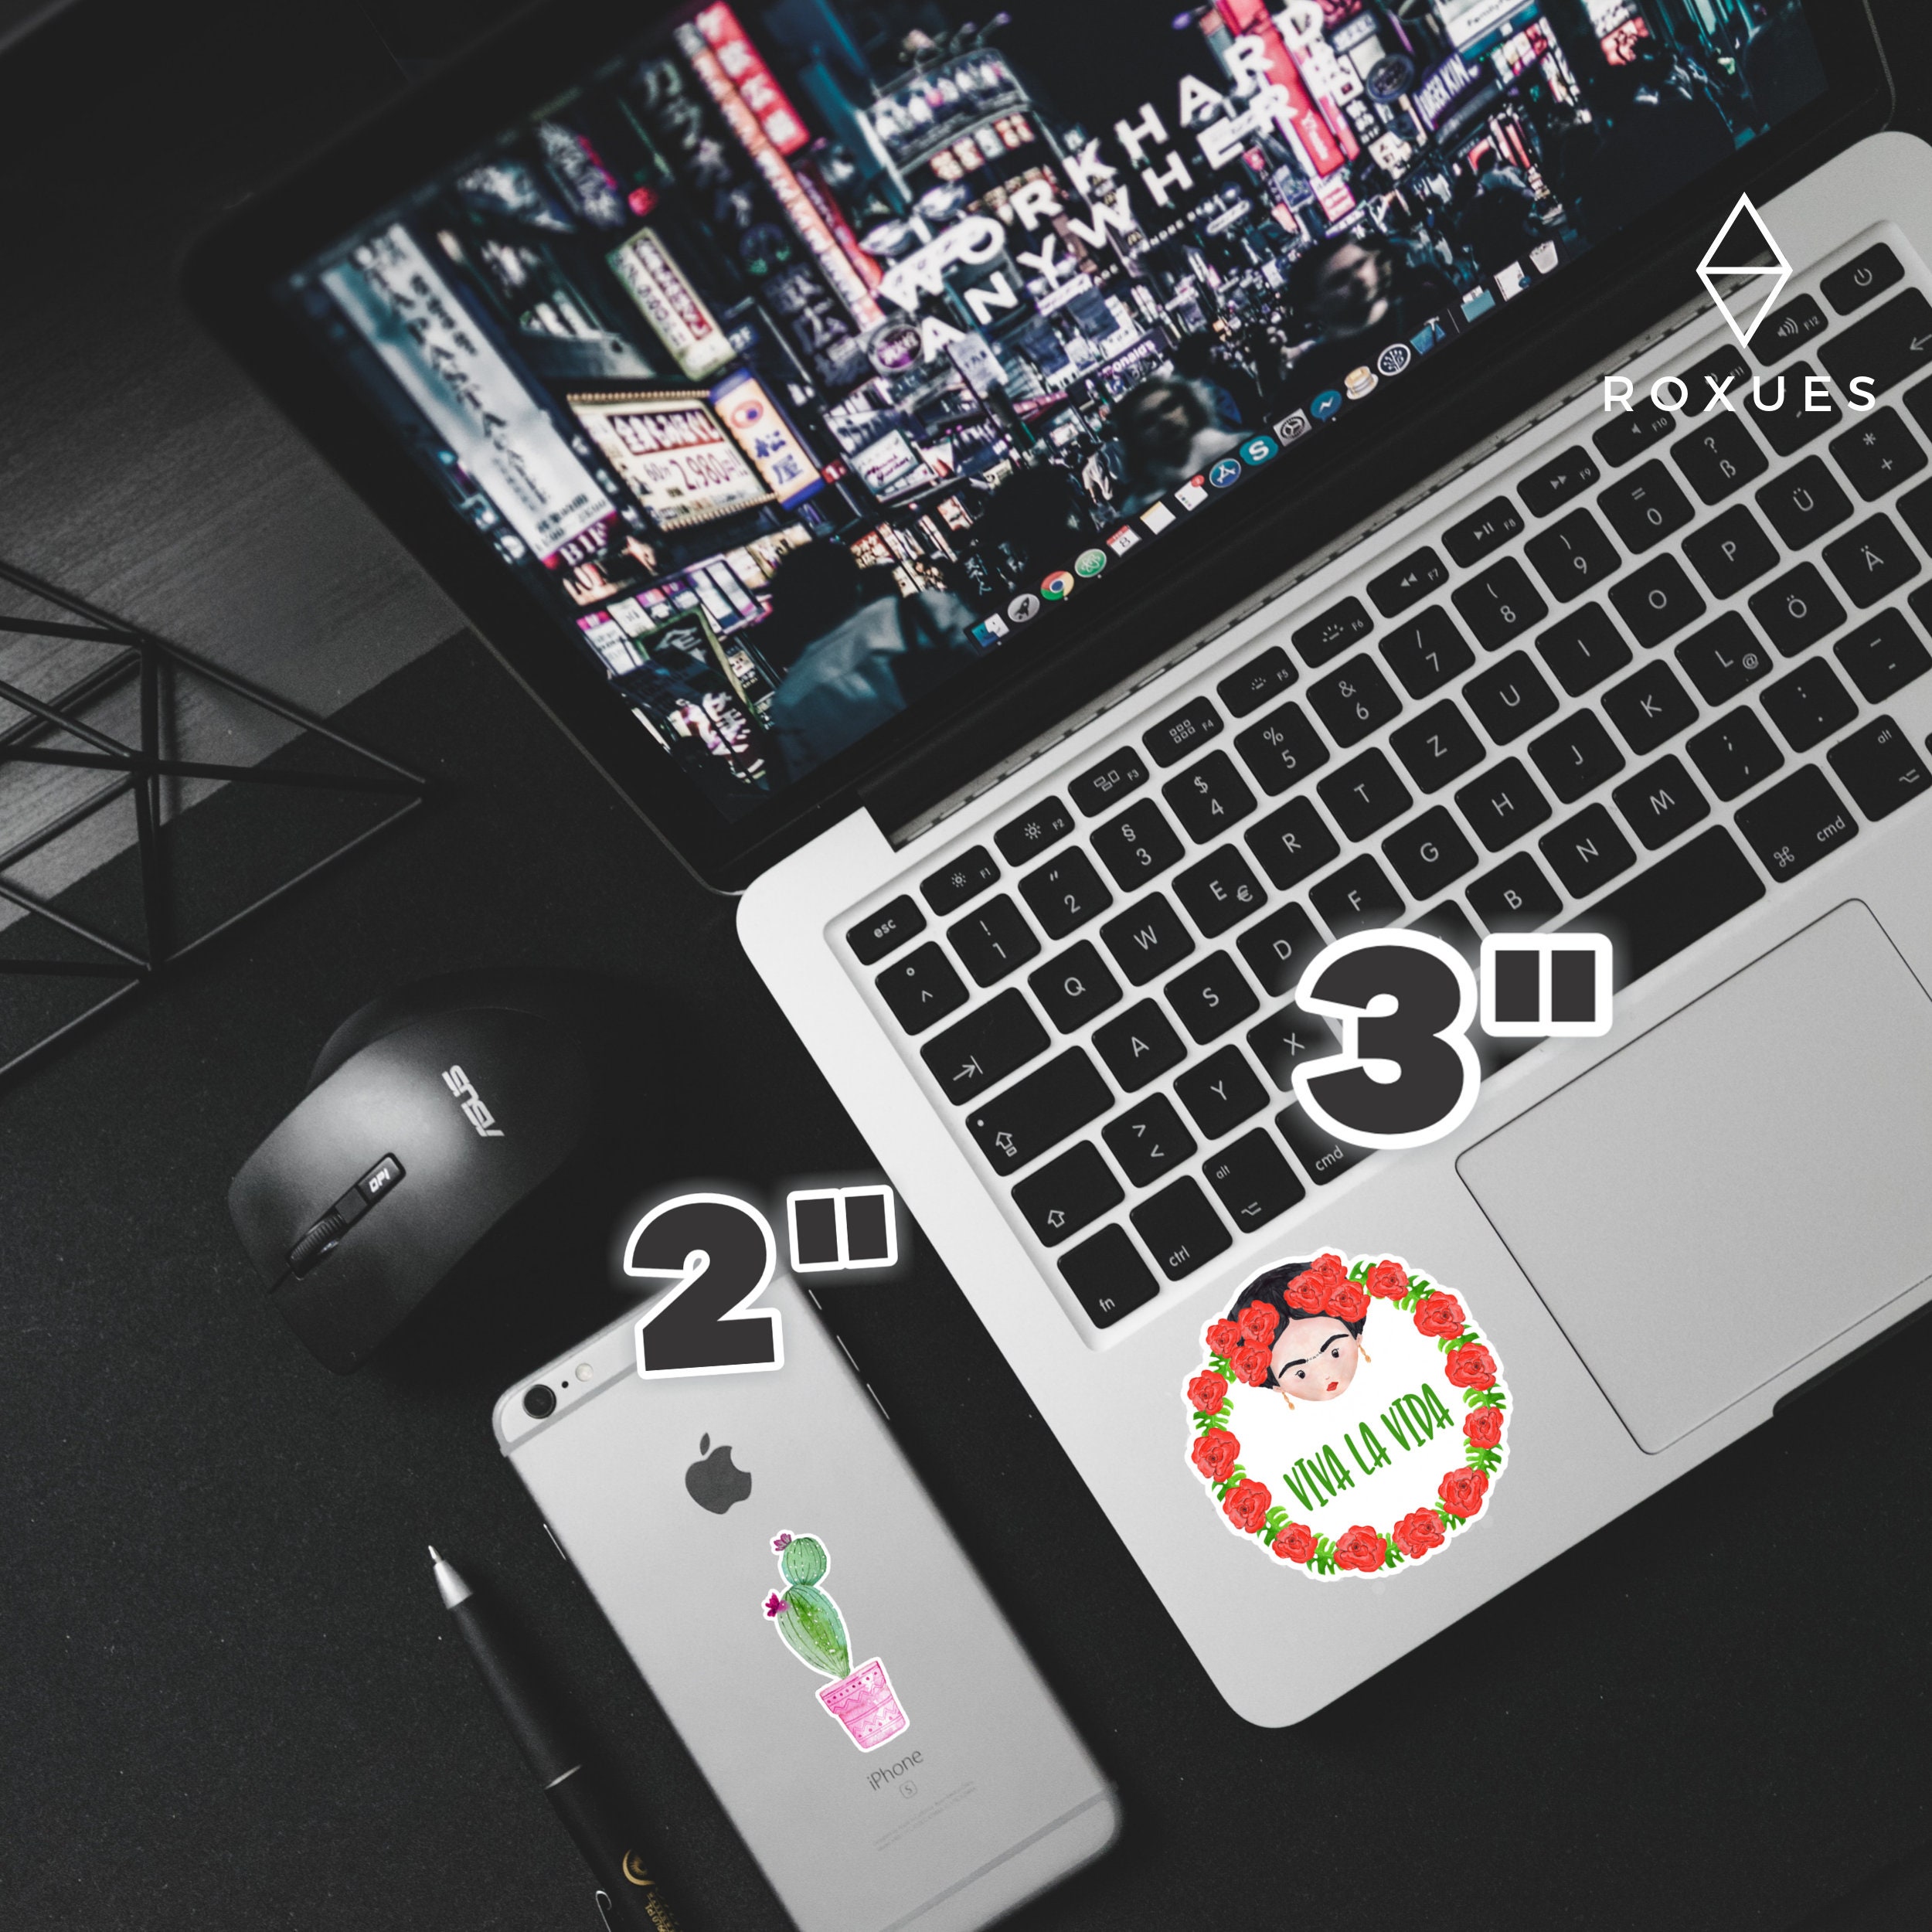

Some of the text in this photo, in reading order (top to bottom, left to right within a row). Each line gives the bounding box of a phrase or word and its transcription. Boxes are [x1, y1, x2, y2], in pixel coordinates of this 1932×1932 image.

[1804, 316, 1818, 330] F12
[368, 395, 391, 420] DPI
[1652, 417, 1668, 431] F10
[1704, 437, 1717, 453] ?
[753, 429, 804, 485] 松屋
[1881, 458, 1893, 470] +
[1580, 468, 1591, 480] F9
[1631, 487, 1646, 500] =
[1793, 488, 1814, 512] Ü
[1503, 519, 1516, 530] F8
[1647, 508, 1662, 526] 0
[1560, 535, 1571, 549] )
[1721, 541, 1736, 562] P
[1573, 556, 1587, 574] 9
[1861, 545, 1884, 571] Ä
[1427, 568, 1439, 580] F7
[1486, 583, 1498, 598] (
[1648, 590, 1667, 609] O
[1500, 605, 1516, 623] 8
[1787, 594, 1807, 618] Ö
[1352, 620, 1364, 631] F6
[1577, 639, 1590, 657] I
[1425, 651, 1439, 672] 7
[1715, 651, 1734, 668] L
[1742, 653, 1759, 669] @
[1277, 669, 1289, 681] F5
[1338, 680, 1356, 698] &
[1499, 685, 1521, 706] U
[1356, 702, 1369, 720] 6
[1640, 695, 1662, 718] K
[1202, 719, 1214, 731] F4
[1263, 727, 1284, 746] %
[1427, 735, 1447, 757] Z
[1878, 730, 1892, 743] alt
[1281, 750, 1296, 769] 5
[1571, 745, 1583, 765] J
[1127, 769, 1139, 781] F3
[1193, 776, 1209, 794] $
[1353, 784, 1369, 803] T
[1211, 798, 1224, 815] 4
[1492, 792, 1514, 816] H
[1649, 789, 1675, 815] M
[1052, 818, 1064, 830] F2
[1121, 824, 1136, 842] §
[1817, 815, 1845, 842] cmd
[1281, 832, 1301, 853] R
[1420, 842, 1439, 862] G
[1576, 838, 1599, 862] N
[1136, 848, 1152, 866] 3
[980, 867, 991, 879] F1
[1209, 880, 1227, 901] E
[1236, 884, 1253, 903] €
[1503, 889, 1522, 910] B
[1064, 894, 1081, 913] 2
[1347, 889, 1362, 912] F
[873, 919, 896, 938] esc
[979, 920, 991, 936] !
[1133, 925, 1158, 951] W
[992, 942, 1006, 959] 1
[1273, 939, 1292, 961] D
[1064, 977, 1086, 997] Q
[1202, 987, 1219, 1008] S
[1131, 1036, 1150, 1058] A
[1283, 1032, 1305, 1056] X
[1210, 1080, 1227, 1100] Y
[441, 1064, 505, 1138] ASUS
[1315, 1144, 1344, 1171] cmd
[1216, 1165, 1230, 1179] alt
[1168, 1245, 1190, 1267] ctrl
[1099, 1298, 1116, 1312] fn
[1283, 1383, 1454, 1512] VIVA LA VIDA
[866, 1750, 924, 1791] iPhone
